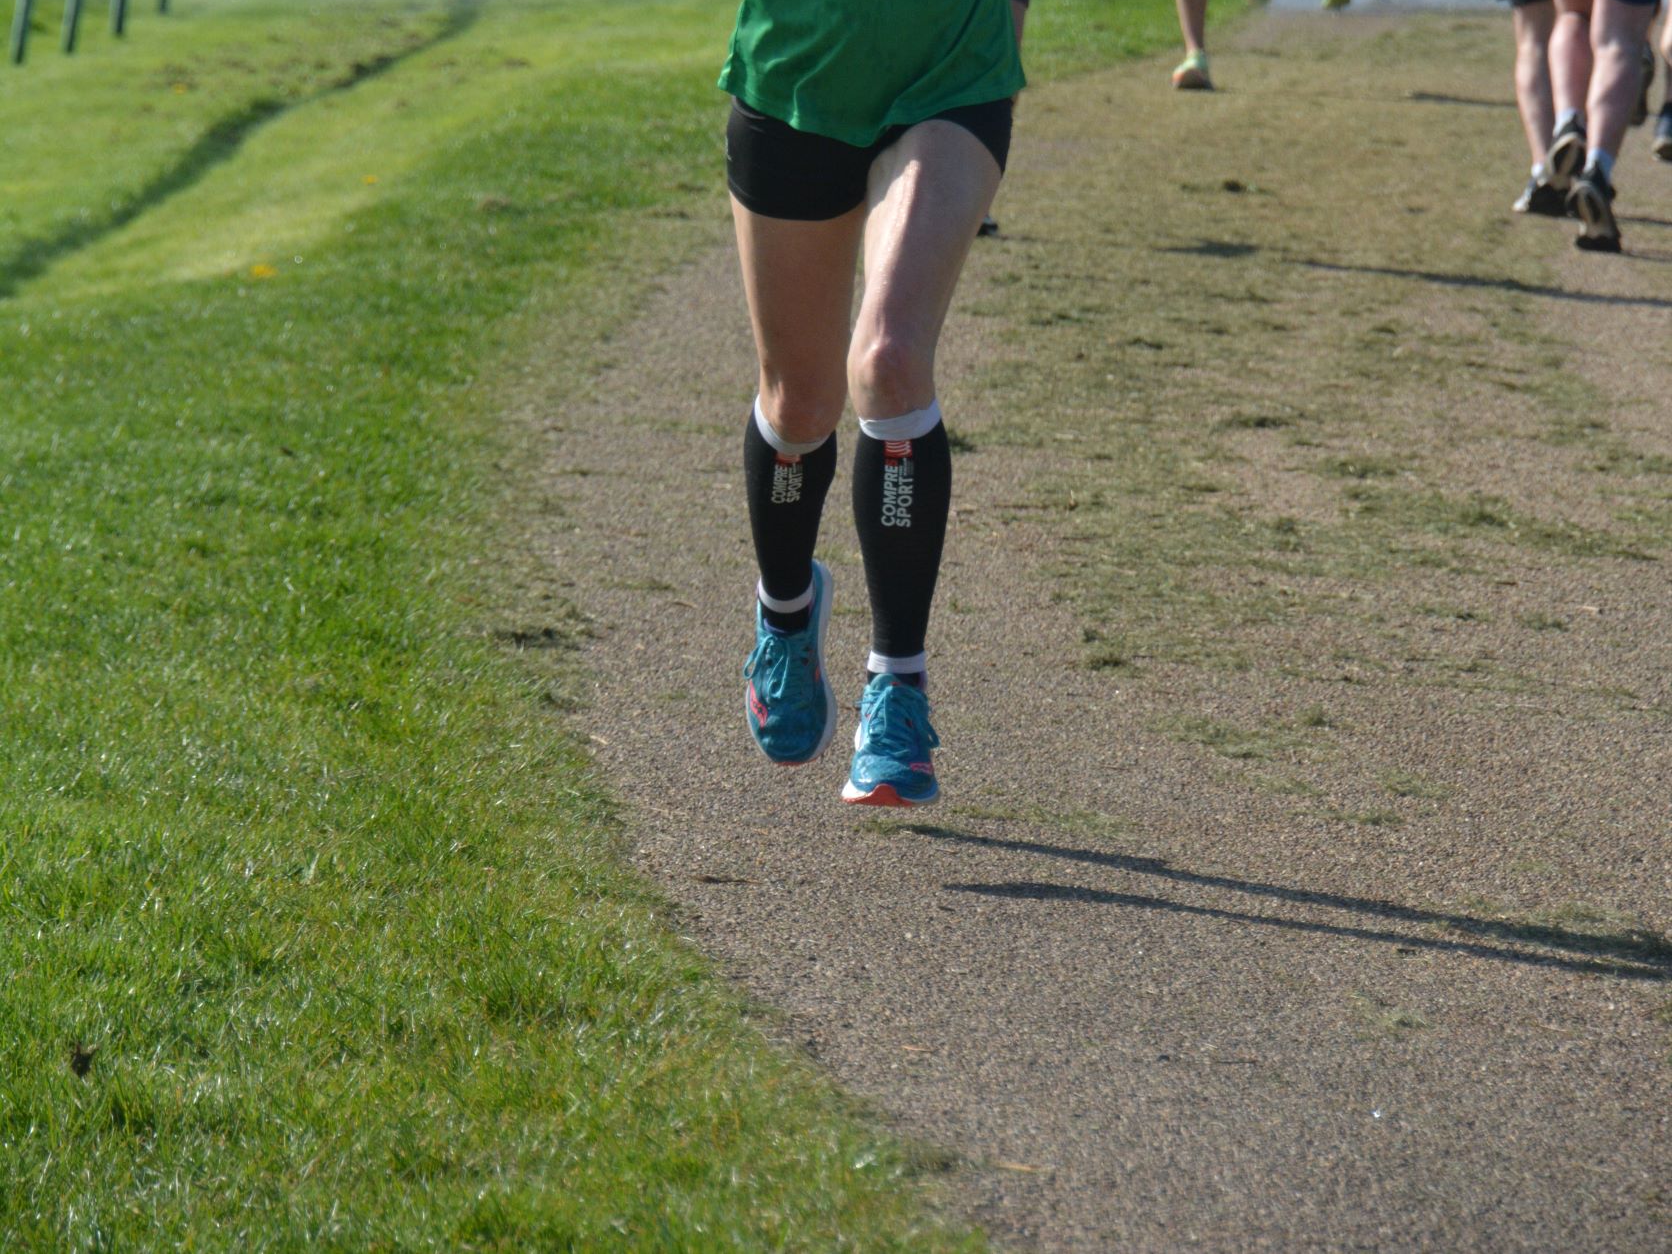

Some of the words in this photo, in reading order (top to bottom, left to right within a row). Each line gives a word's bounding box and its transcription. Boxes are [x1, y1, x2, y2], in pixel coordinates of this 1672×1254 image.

[771, 464, 788, 504] COMPRE
[786, 473, 803, 503] SPORT
[896, 475, 914, 528] SPORT
